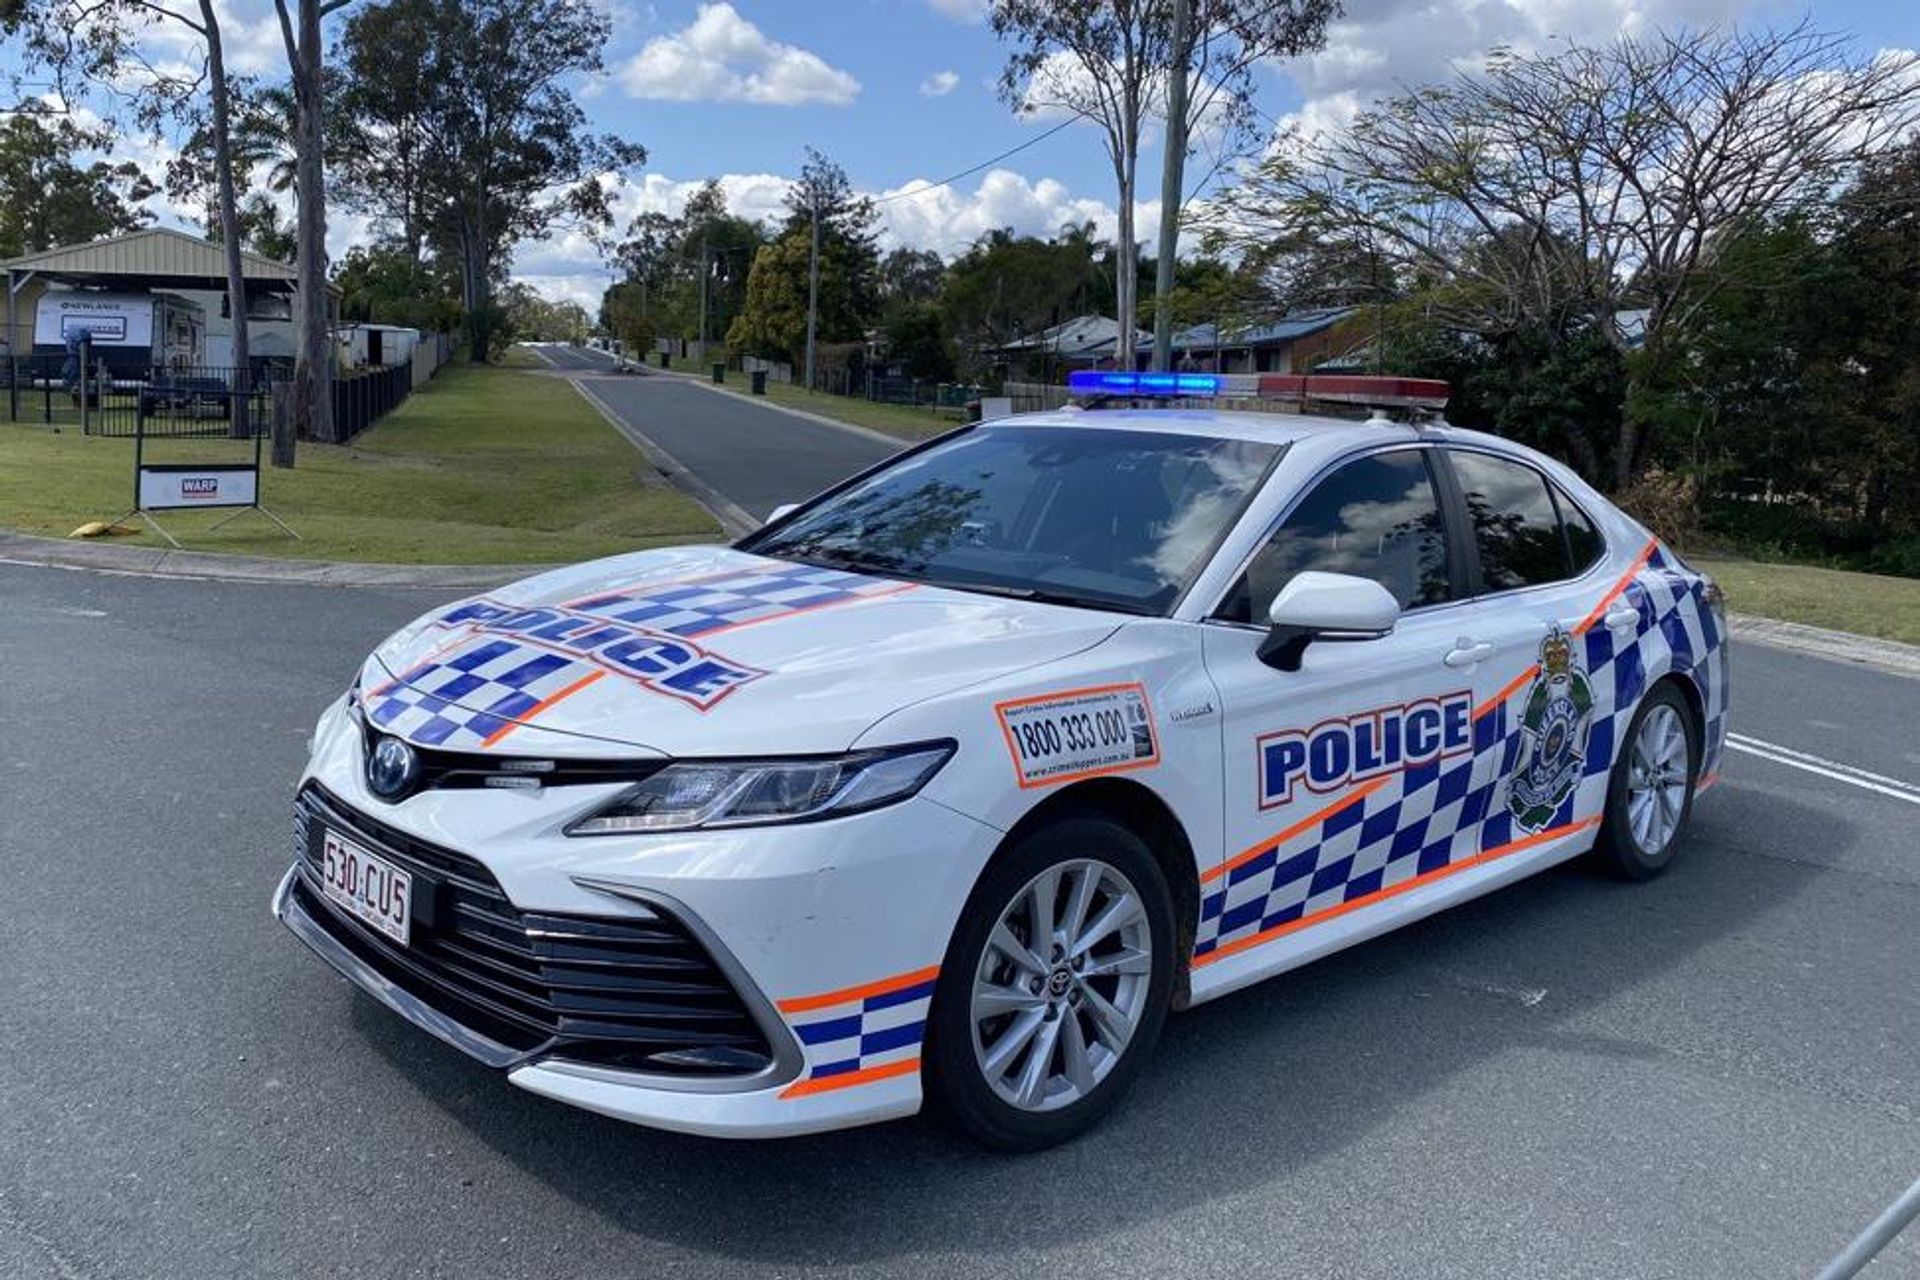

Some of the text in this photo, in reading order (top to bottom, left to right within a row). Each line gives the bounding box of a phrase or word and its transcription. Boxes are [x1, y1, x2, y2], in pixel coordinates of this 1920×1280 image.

[183, 480, 217, 492] WARP
[438, 600, 753, 700] POLICE
[1011, 719, 1061, 759] 1800
[1060, 713, 1096, 751] 333
[1095, 708, 1127, 746] 000
[1262, 698, 1470, 800] POLICE
[326, 841, 358, 897] 530
